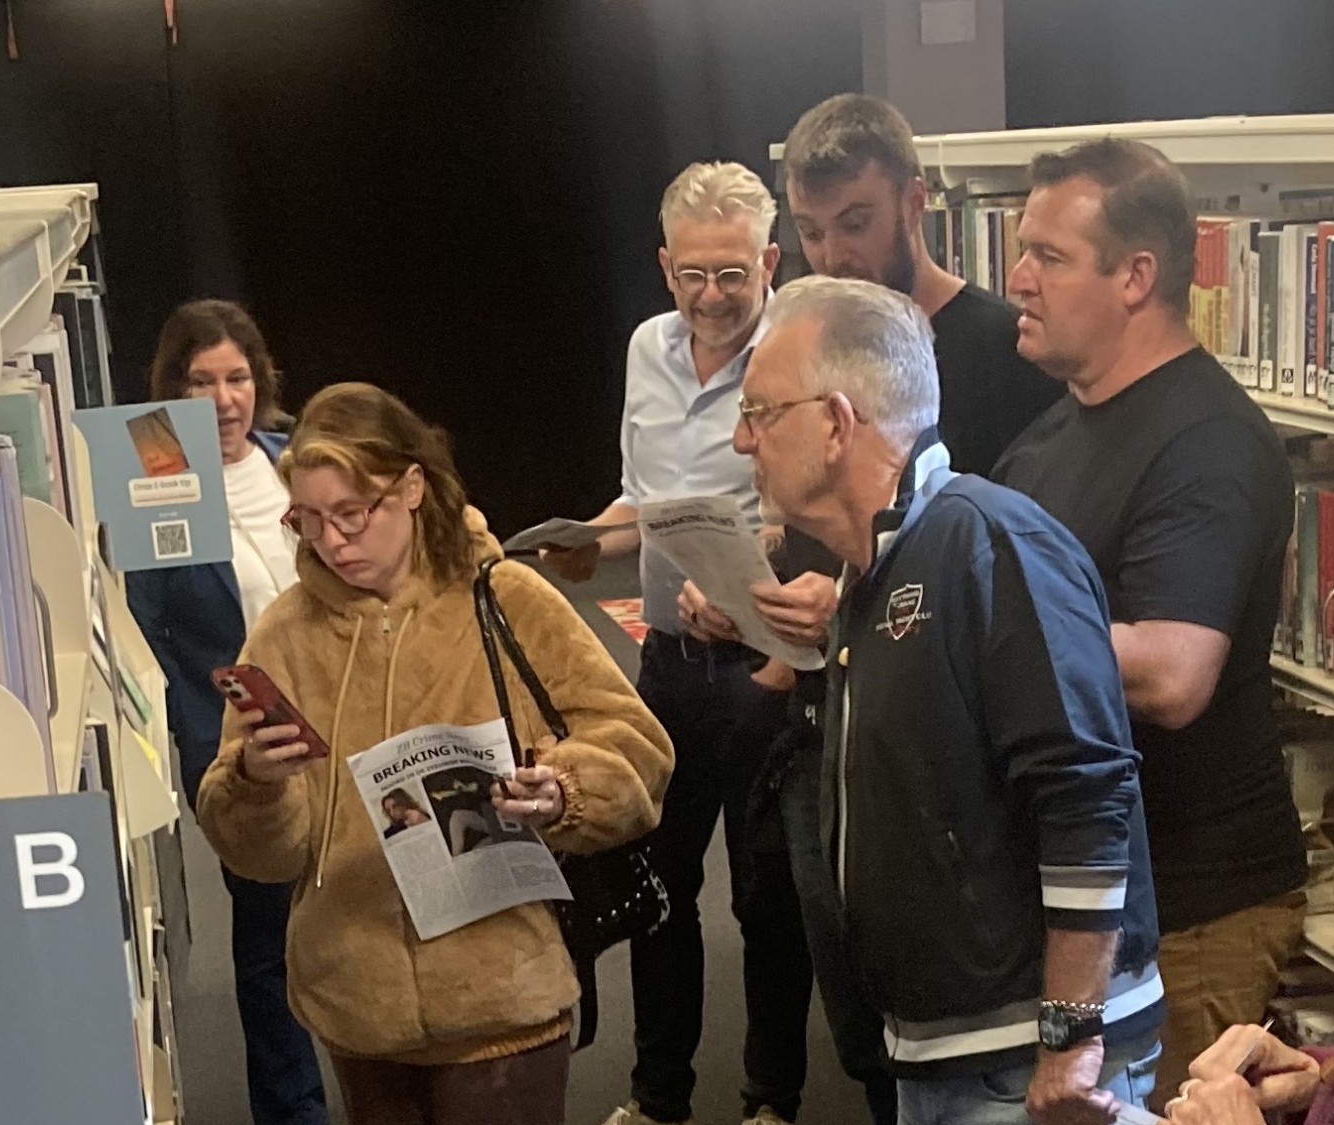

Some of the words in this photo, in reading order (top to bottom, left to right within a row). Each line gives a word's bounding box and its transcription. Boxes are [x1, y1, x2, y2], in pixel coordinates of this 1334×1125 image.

[412, 734, 443, 746] Crime
[372, 744, 451, 784] BREAKING
[453, 744, 496, 761] NEWS
[14, 831, 85, 910] B
